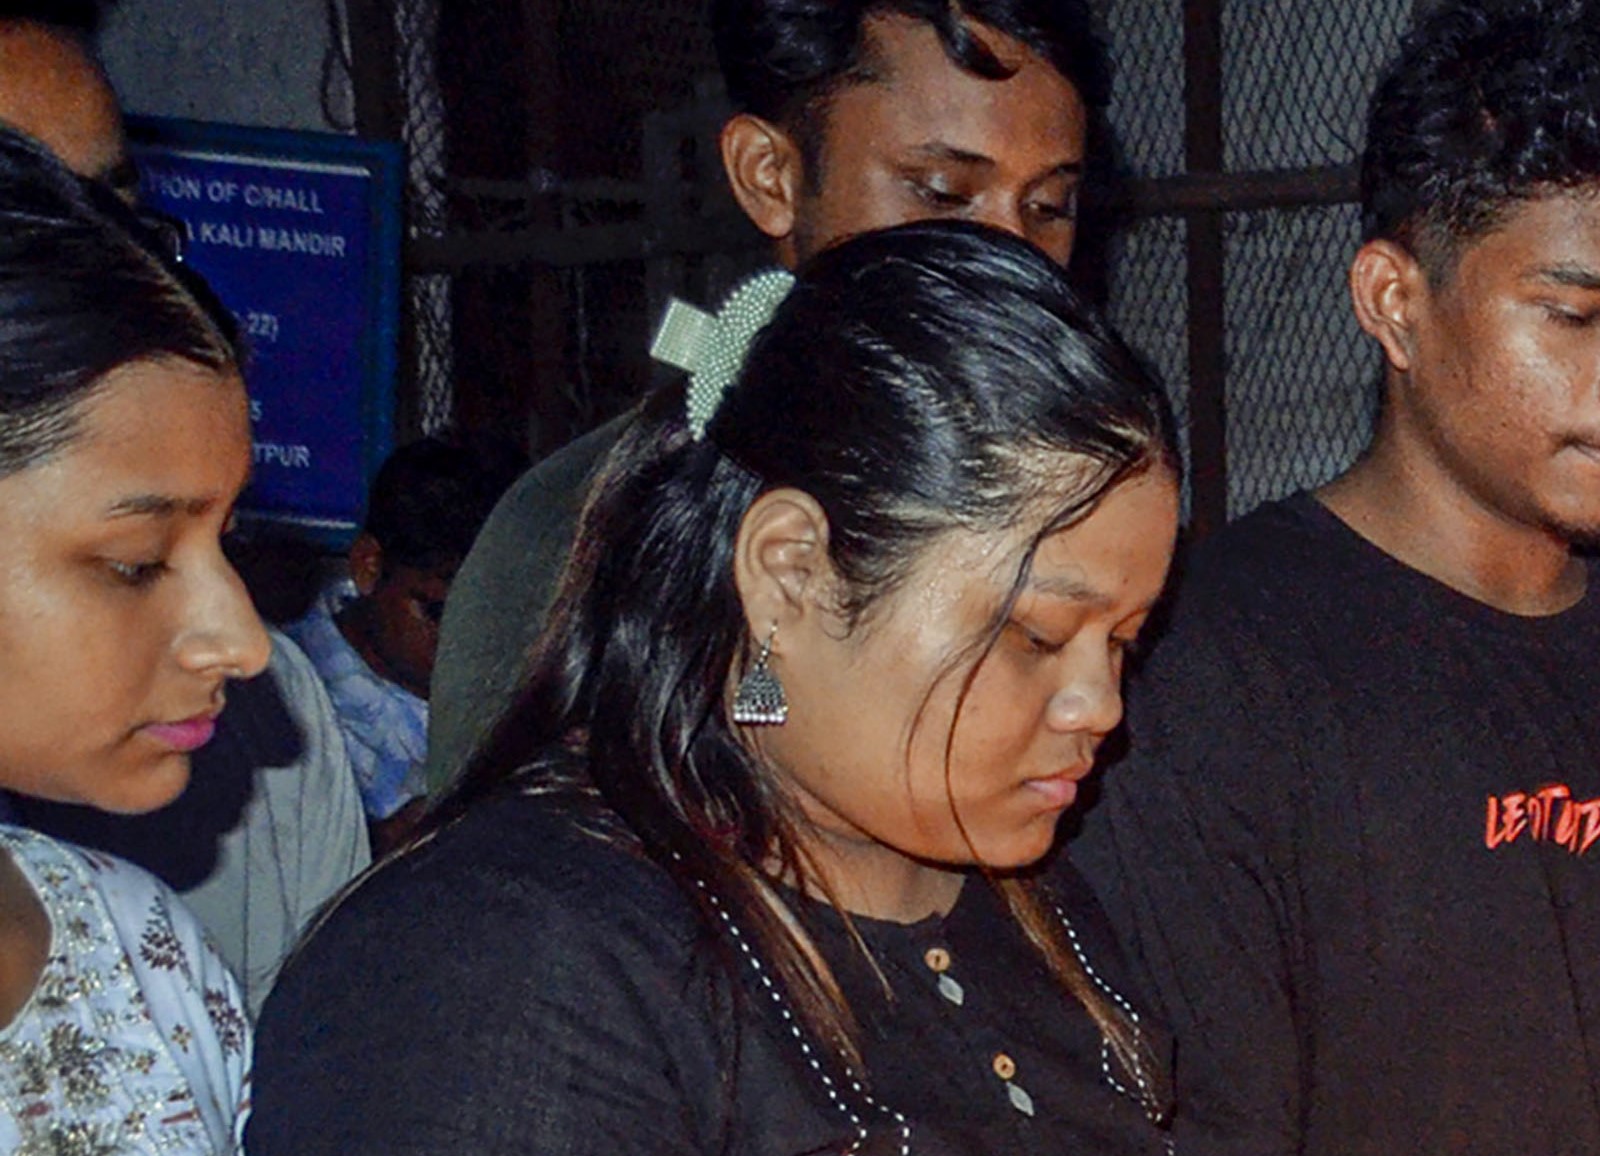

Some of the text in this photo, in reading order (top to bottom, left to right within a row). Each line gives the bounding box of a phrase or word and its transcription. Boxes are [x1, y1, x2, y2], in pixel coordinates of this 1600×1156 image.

[206, 180, 238, 203] OF
[201, 222, 253, 248] KALI
[258, 227, 346, 258] MANDIR
[252, 442, 311, 469] TPUR
